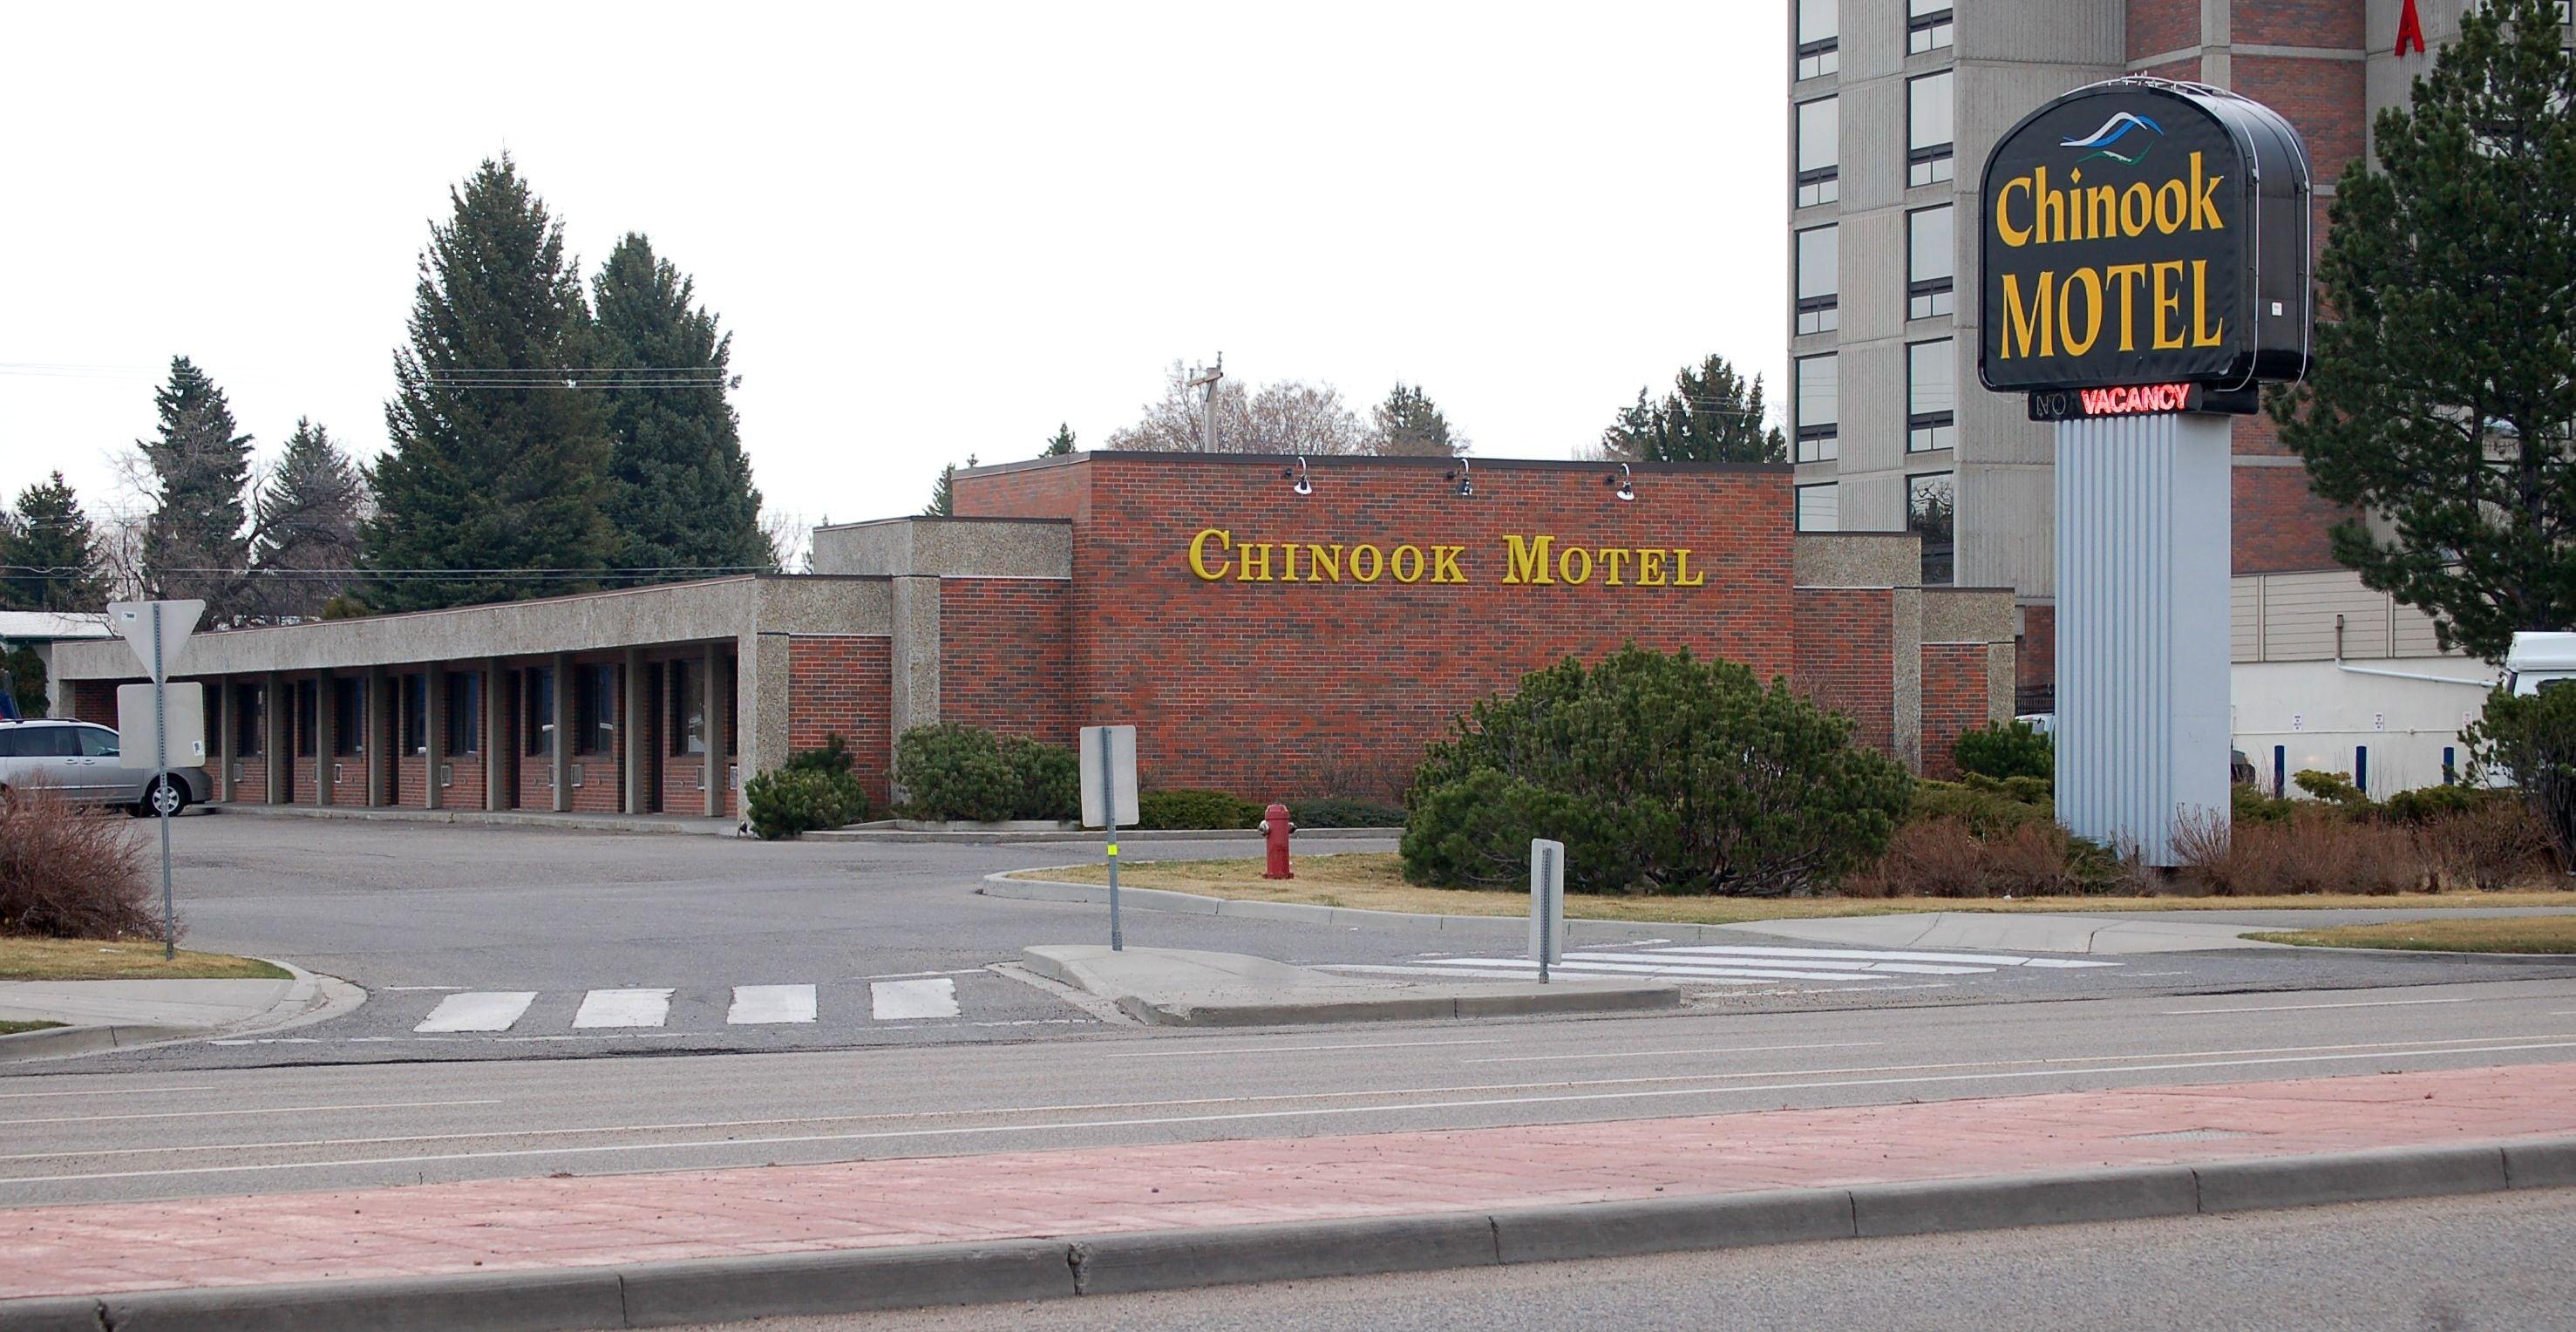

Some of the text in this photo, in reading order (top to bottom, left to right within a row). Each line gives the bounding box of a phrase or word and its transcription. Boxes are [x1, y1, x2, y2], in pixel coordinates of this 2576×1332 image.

[2394, 0, 2425, 56] A
[1995, 151, 2225, 248] Chinook
[2000, 260, 2223, 360] MOTEL
[2036, 383, 2191, 417] NO VACANCY
[1188, 528, 1704, 587] CHINOOK MOTEL
